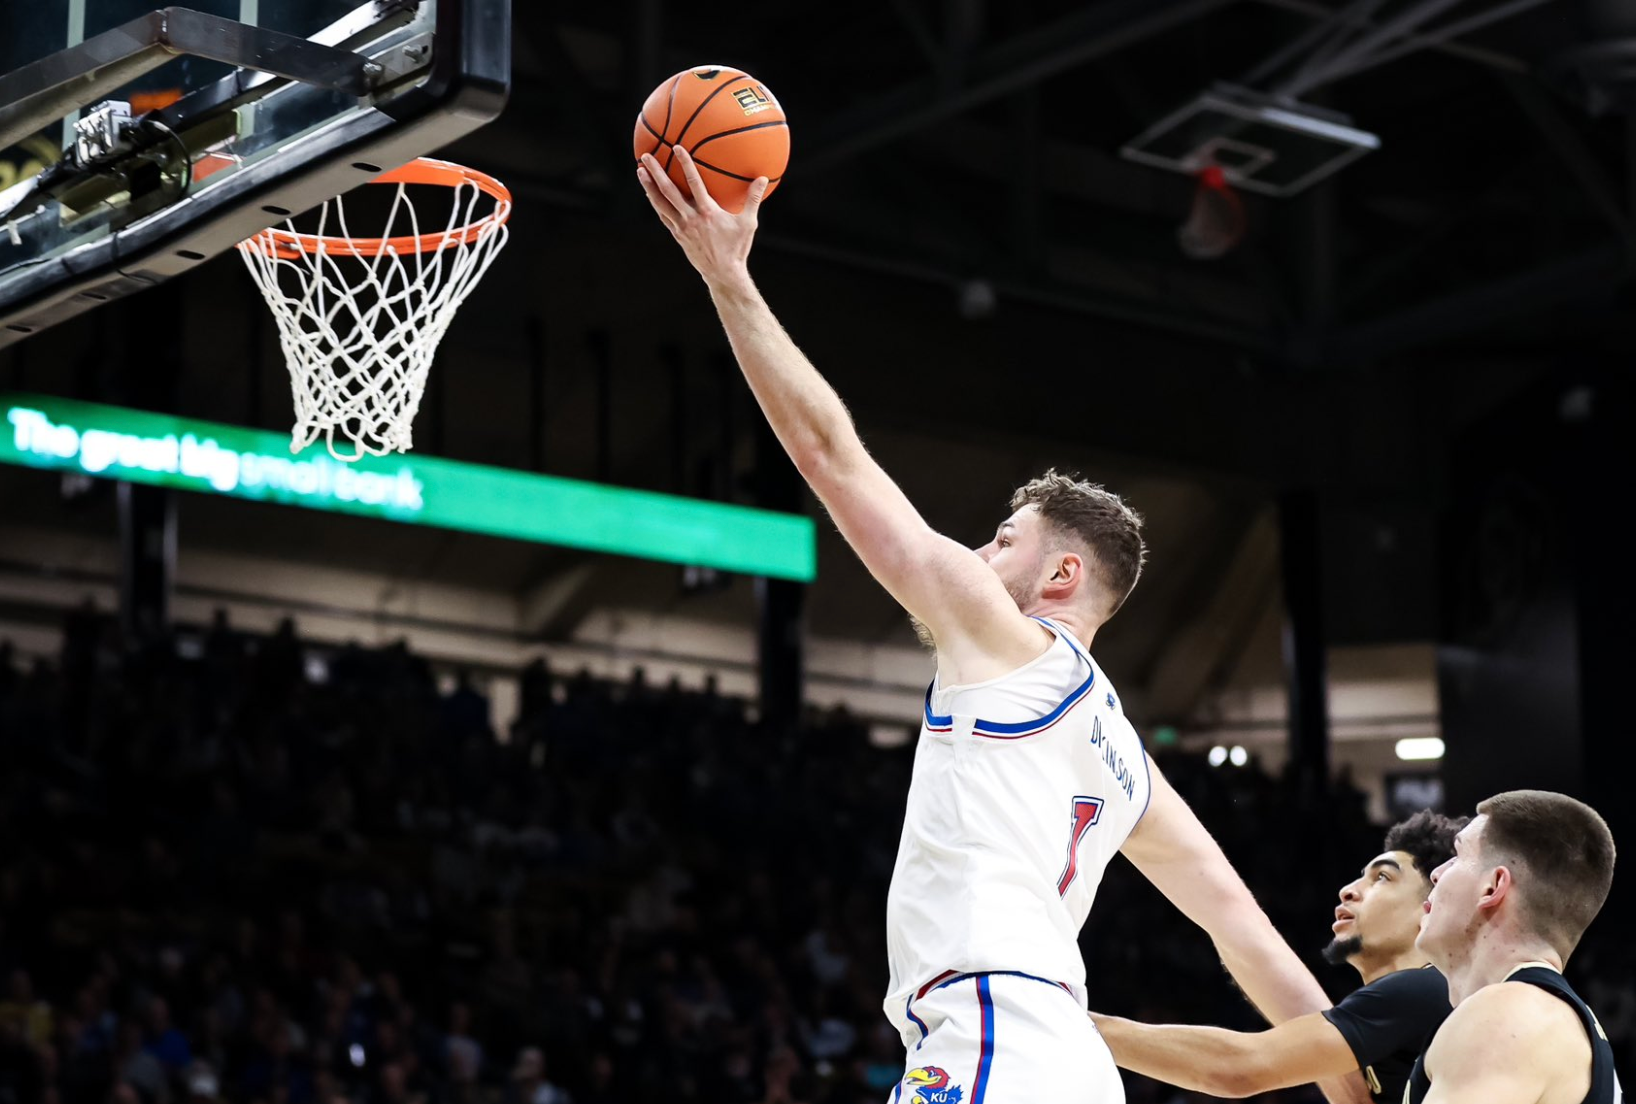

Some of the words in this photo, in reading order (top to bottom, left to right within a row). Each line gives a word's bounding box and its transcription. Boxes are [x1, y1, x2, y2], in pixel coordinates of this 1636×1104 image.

[8, 407, 79, 459] The
[80, 429, 179, 473] great
[180, 433, 240, 491] big
[334, 460, 424, 511] bank
[930, 1092, 948, 1103] KU
